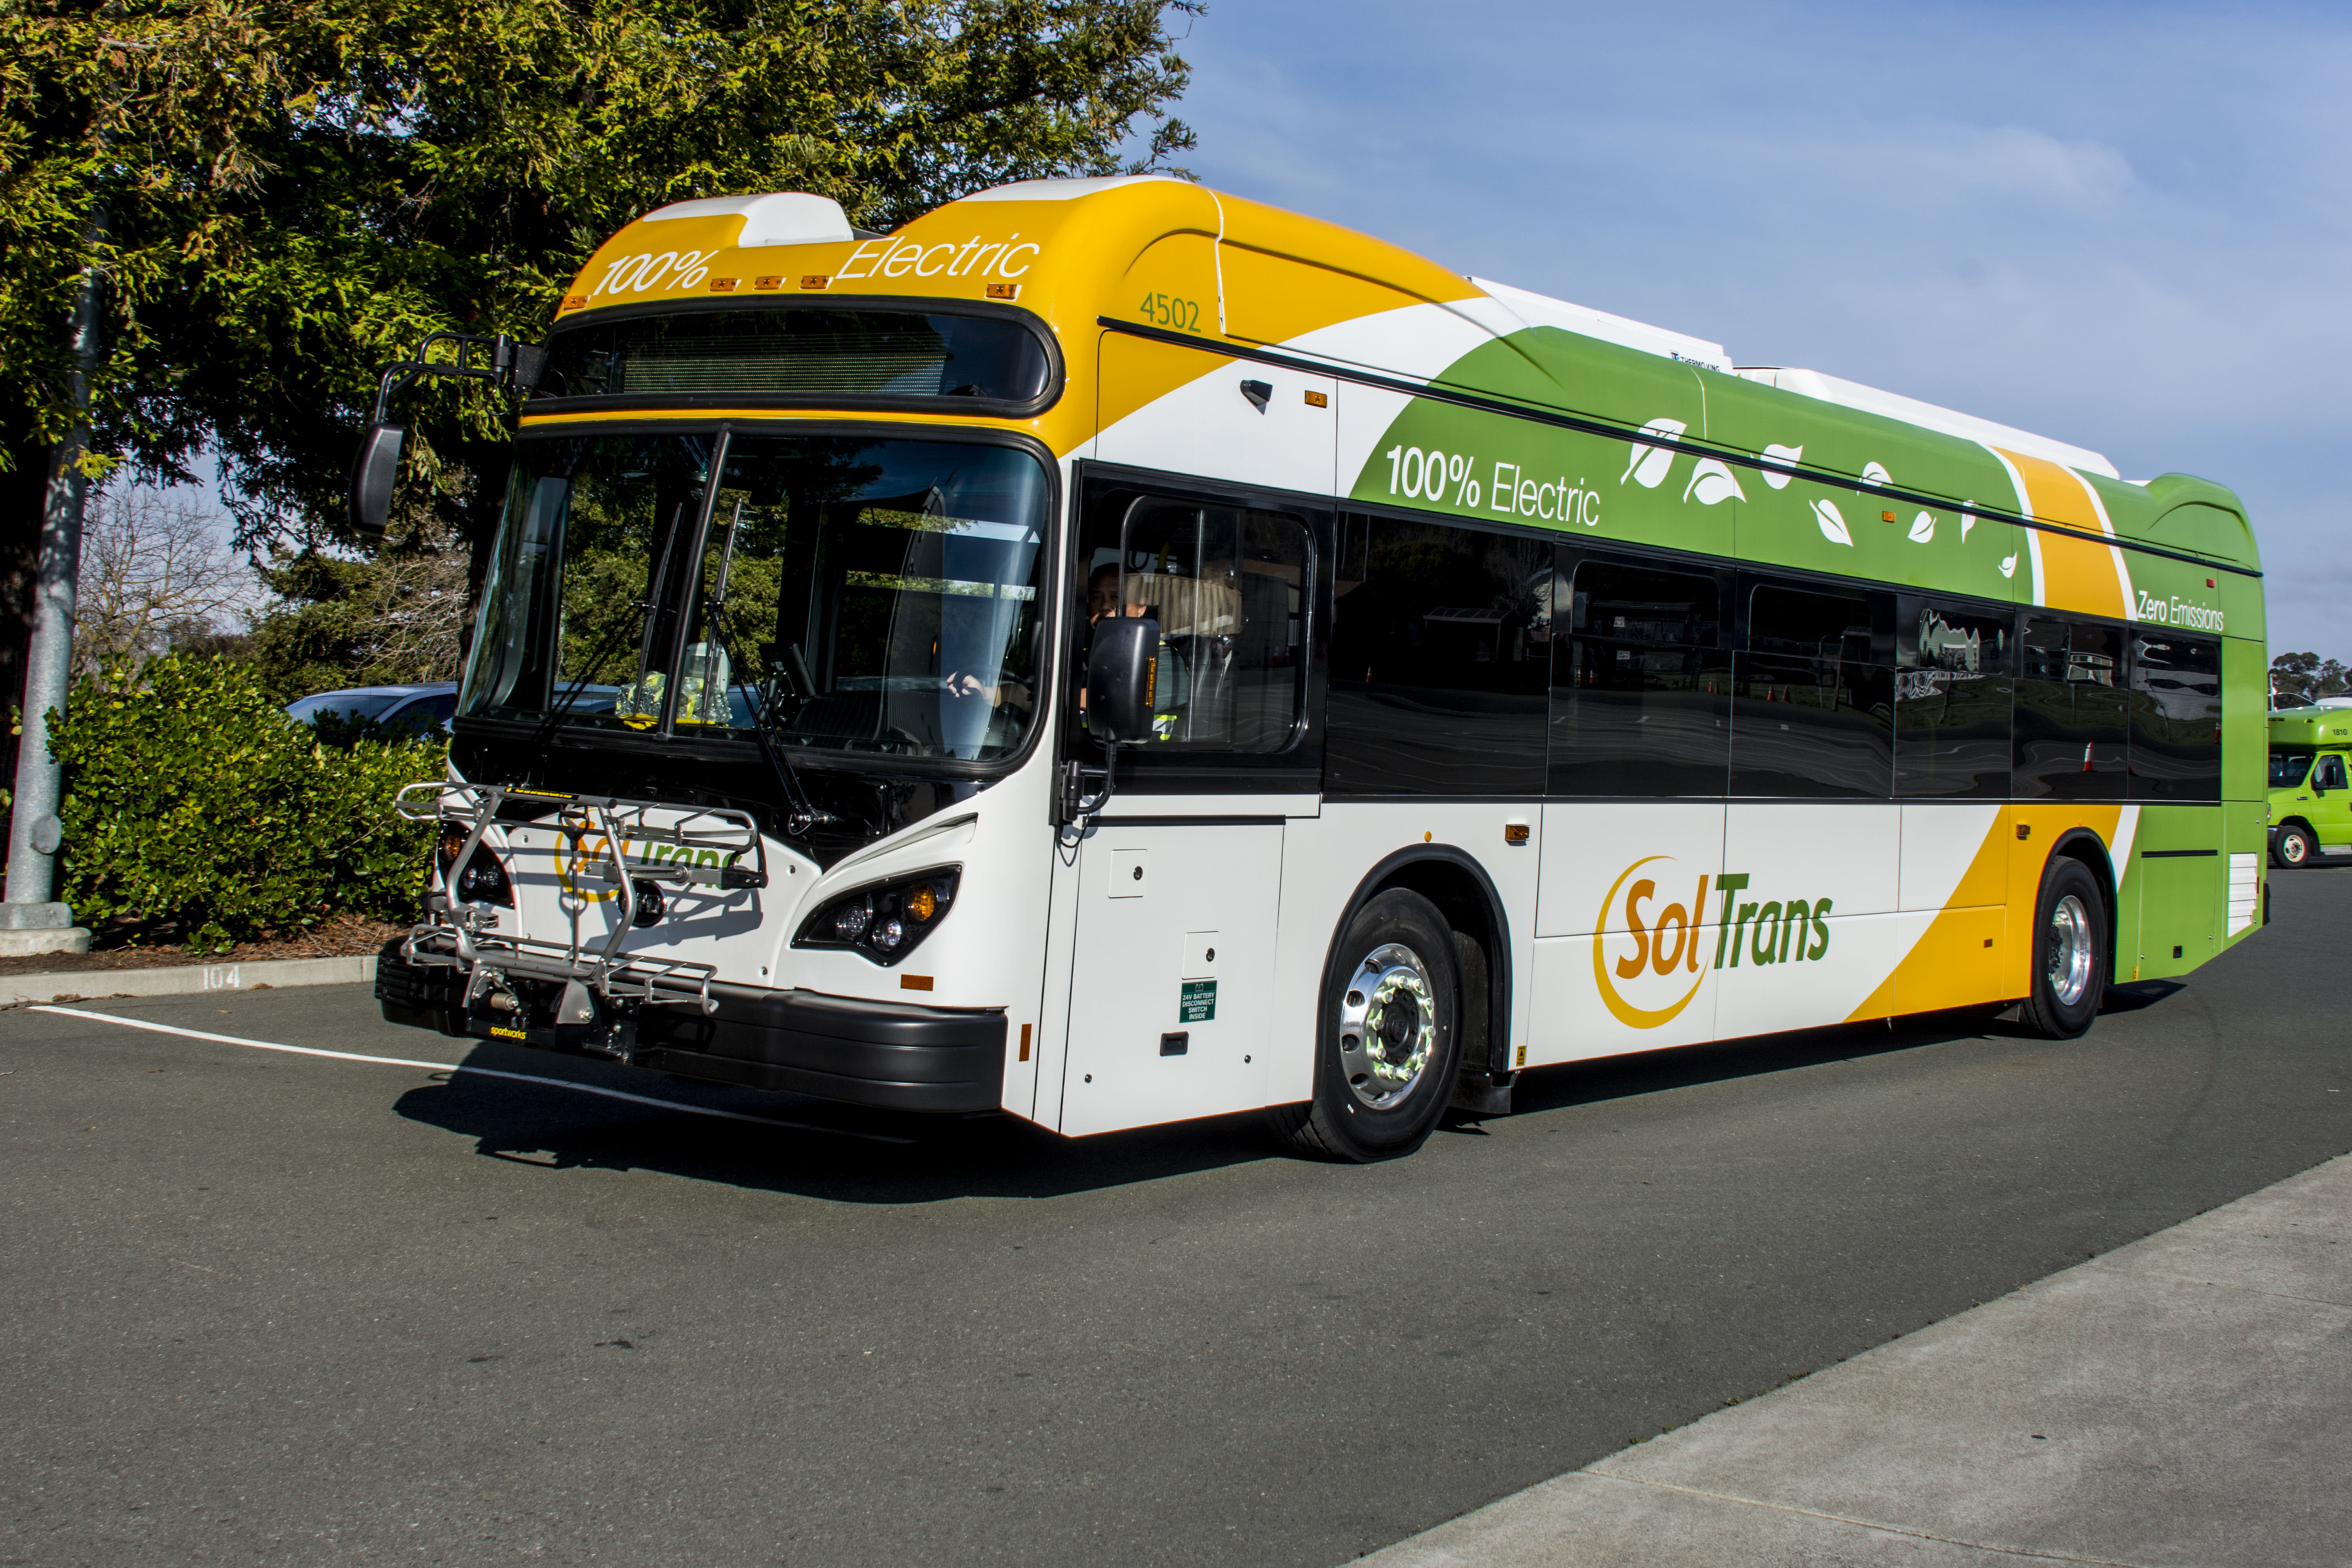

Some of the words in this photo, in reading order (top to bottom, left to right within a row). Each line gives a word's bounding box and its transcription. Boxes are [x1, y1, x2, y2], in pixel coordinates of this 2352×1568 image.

[592, 250, 719, 294] 100%
[835, 233, 1040, 279] Electric
[1140, 292, 1201, 333] 4502
[1681, 357, 1706, 368] THERMO
[1706, 363, 1720, 372] KING
[1387, 445, 1481, 508] 100%
[1491, 461, 1600, 526] Electric
[2137, 590, 2167, 622] Zero
[2170, 595, 2224, 632] Emissions
[203, 965, 241, 990] 104
[1182, 999, 1214, 1007] DISCONNECT
[490, 1027, 526, 1040] sportworks
